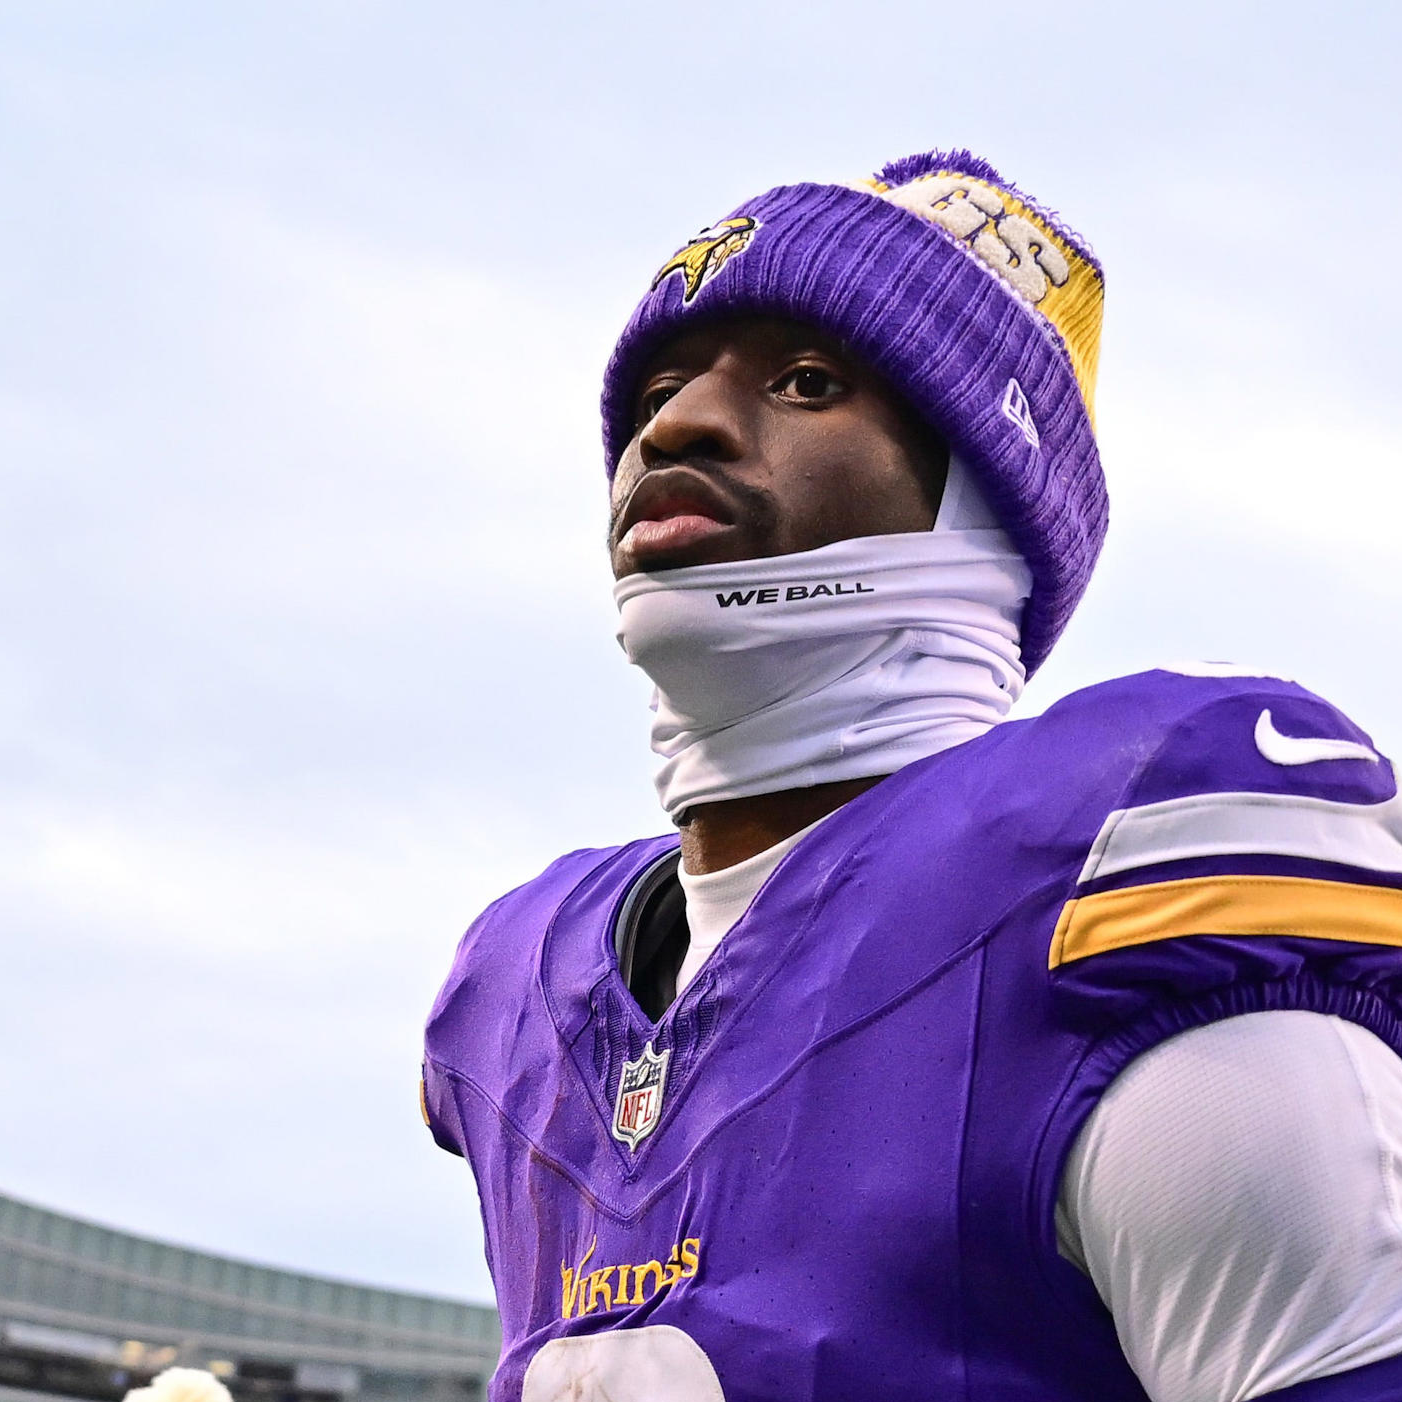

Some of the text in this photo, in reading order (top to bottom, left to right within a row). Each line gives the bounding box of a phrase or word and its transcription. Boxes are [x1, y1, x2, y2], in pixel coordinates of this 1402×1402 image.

[715, 582, 875, 608] WE BALL
[620, 1090, 653, 1131] NFL
